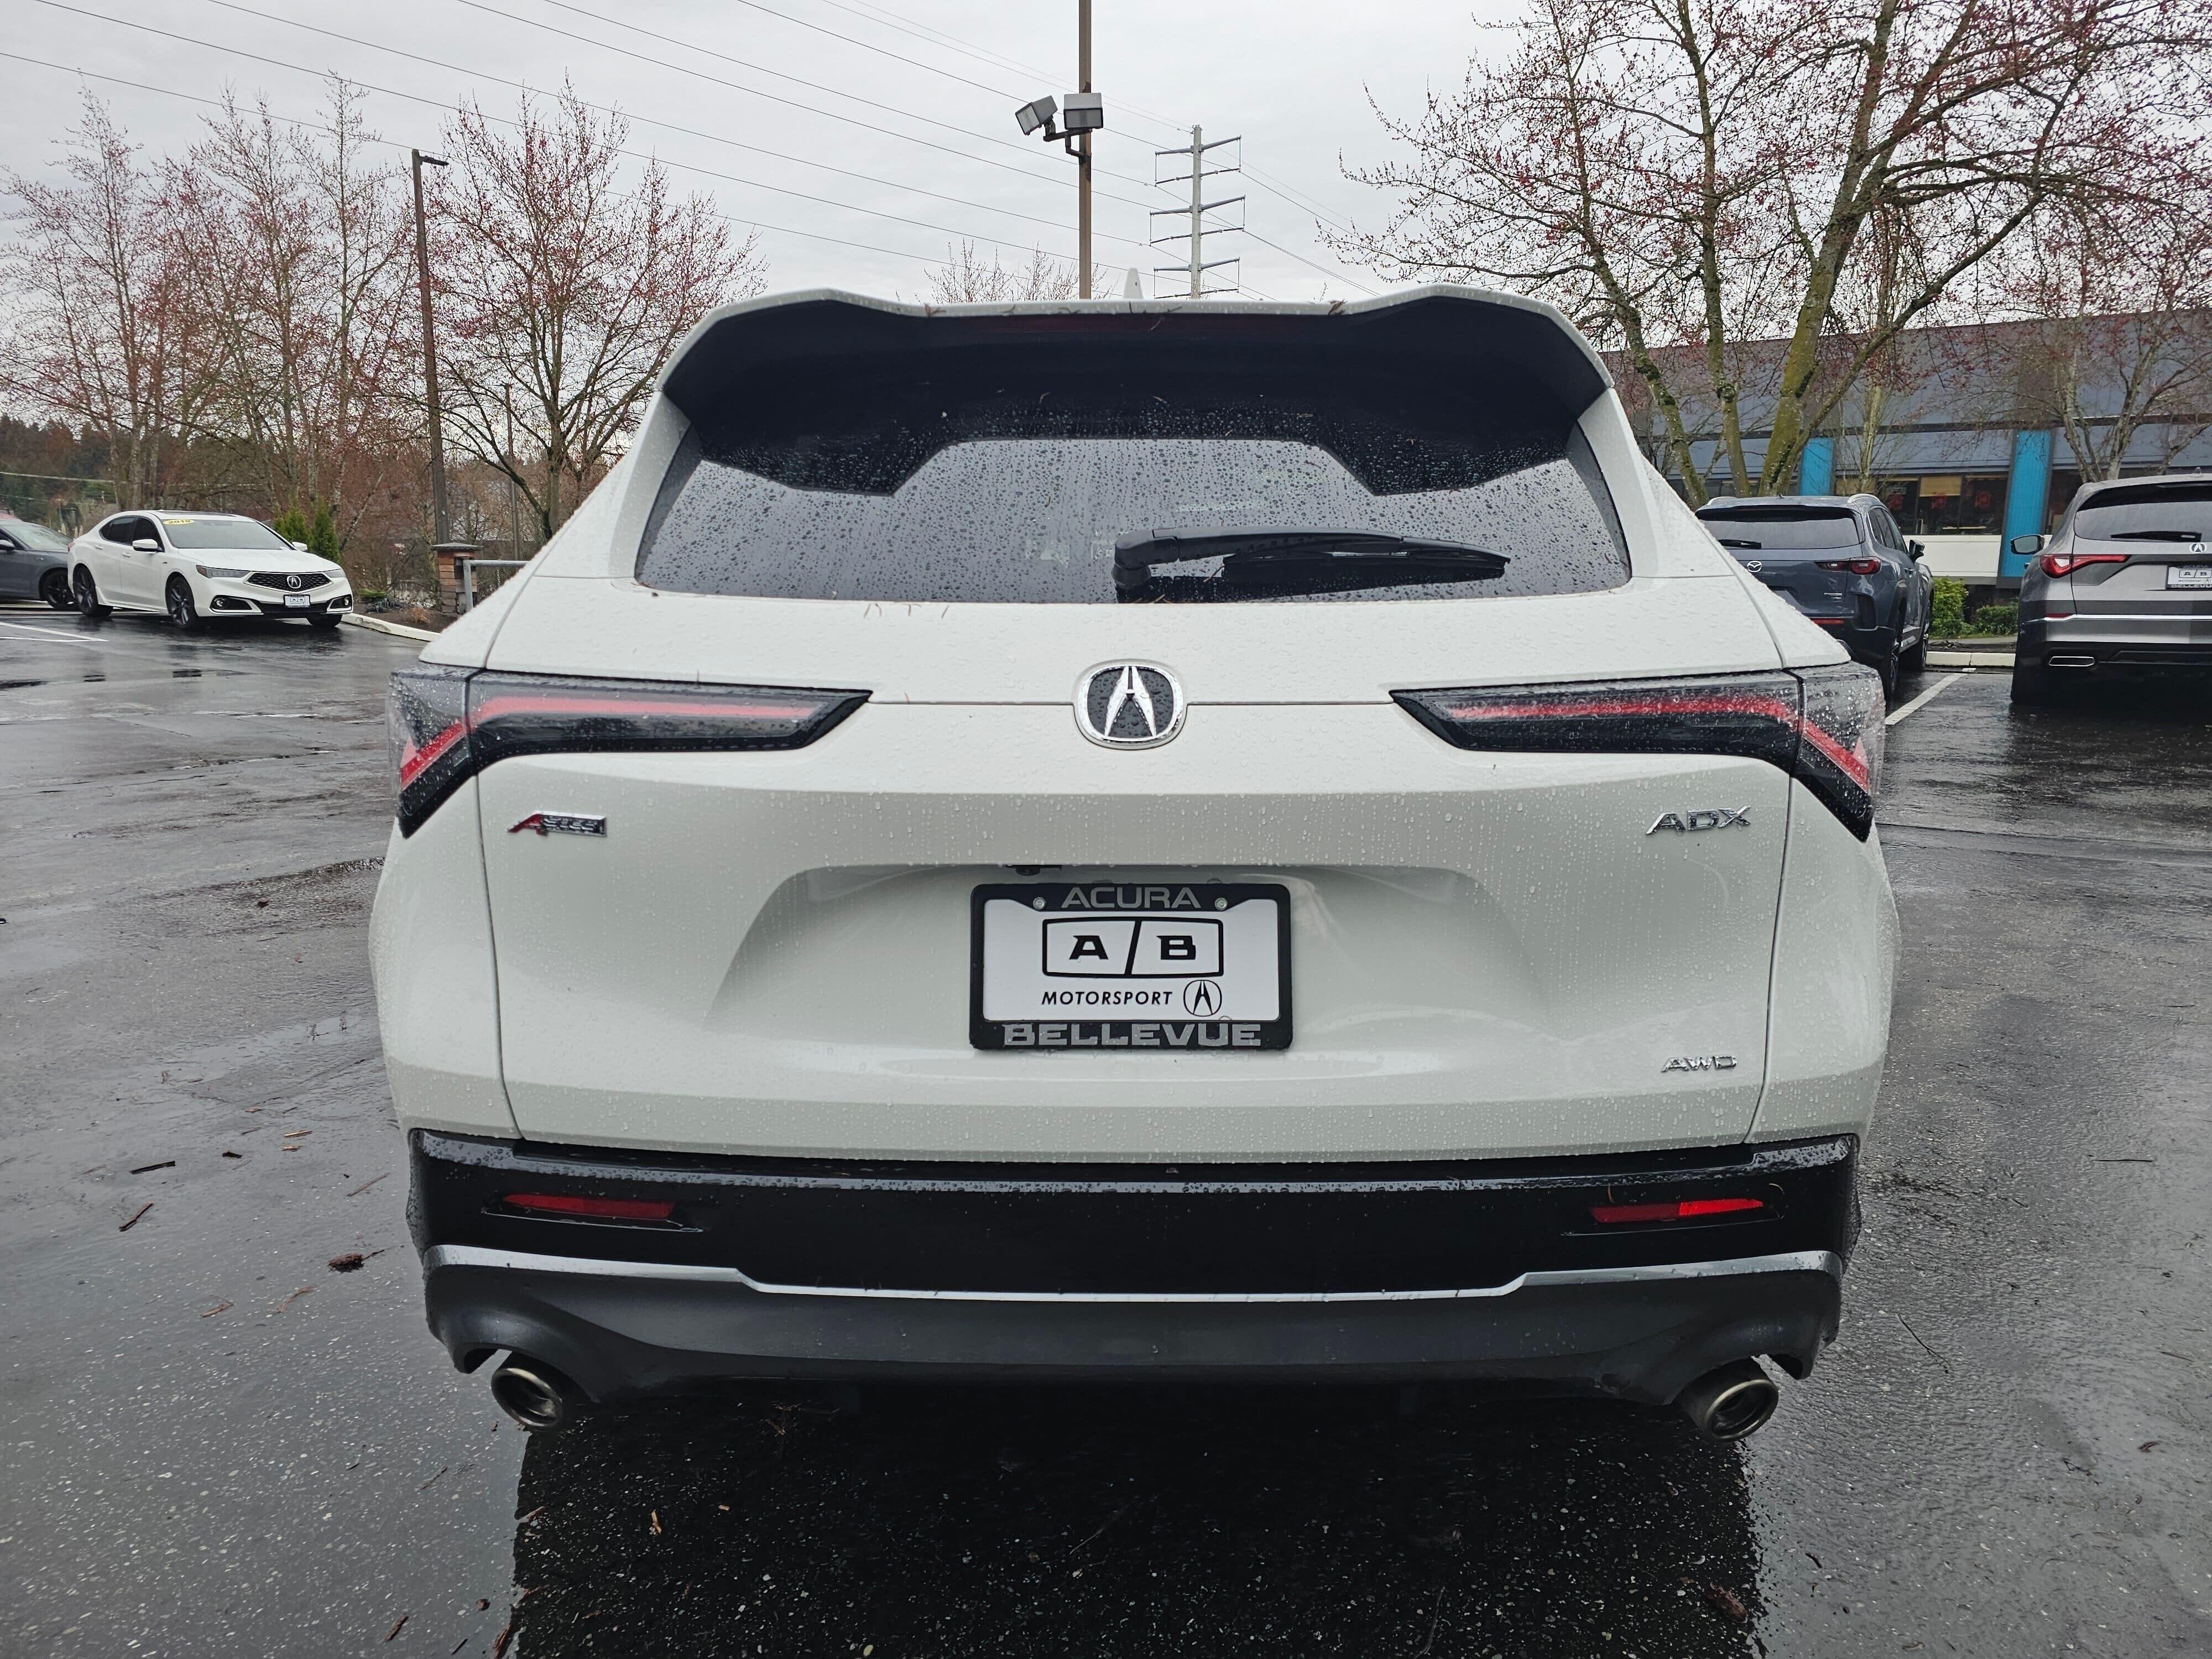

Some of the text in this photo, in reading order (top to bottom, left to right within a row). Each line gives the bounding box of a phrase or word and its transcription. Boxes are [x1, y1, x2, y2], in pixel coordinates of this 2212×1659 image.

[1646, 805, 1751, 835] ADX
[1061, 887, 1201, 909] ACURA
[1041, 991, 1173, 1005] MOTORSPORT
[1001, 1022, 1261, 1047] BELLEVUE
[1660, 1055, 1738, 1073] AWD
